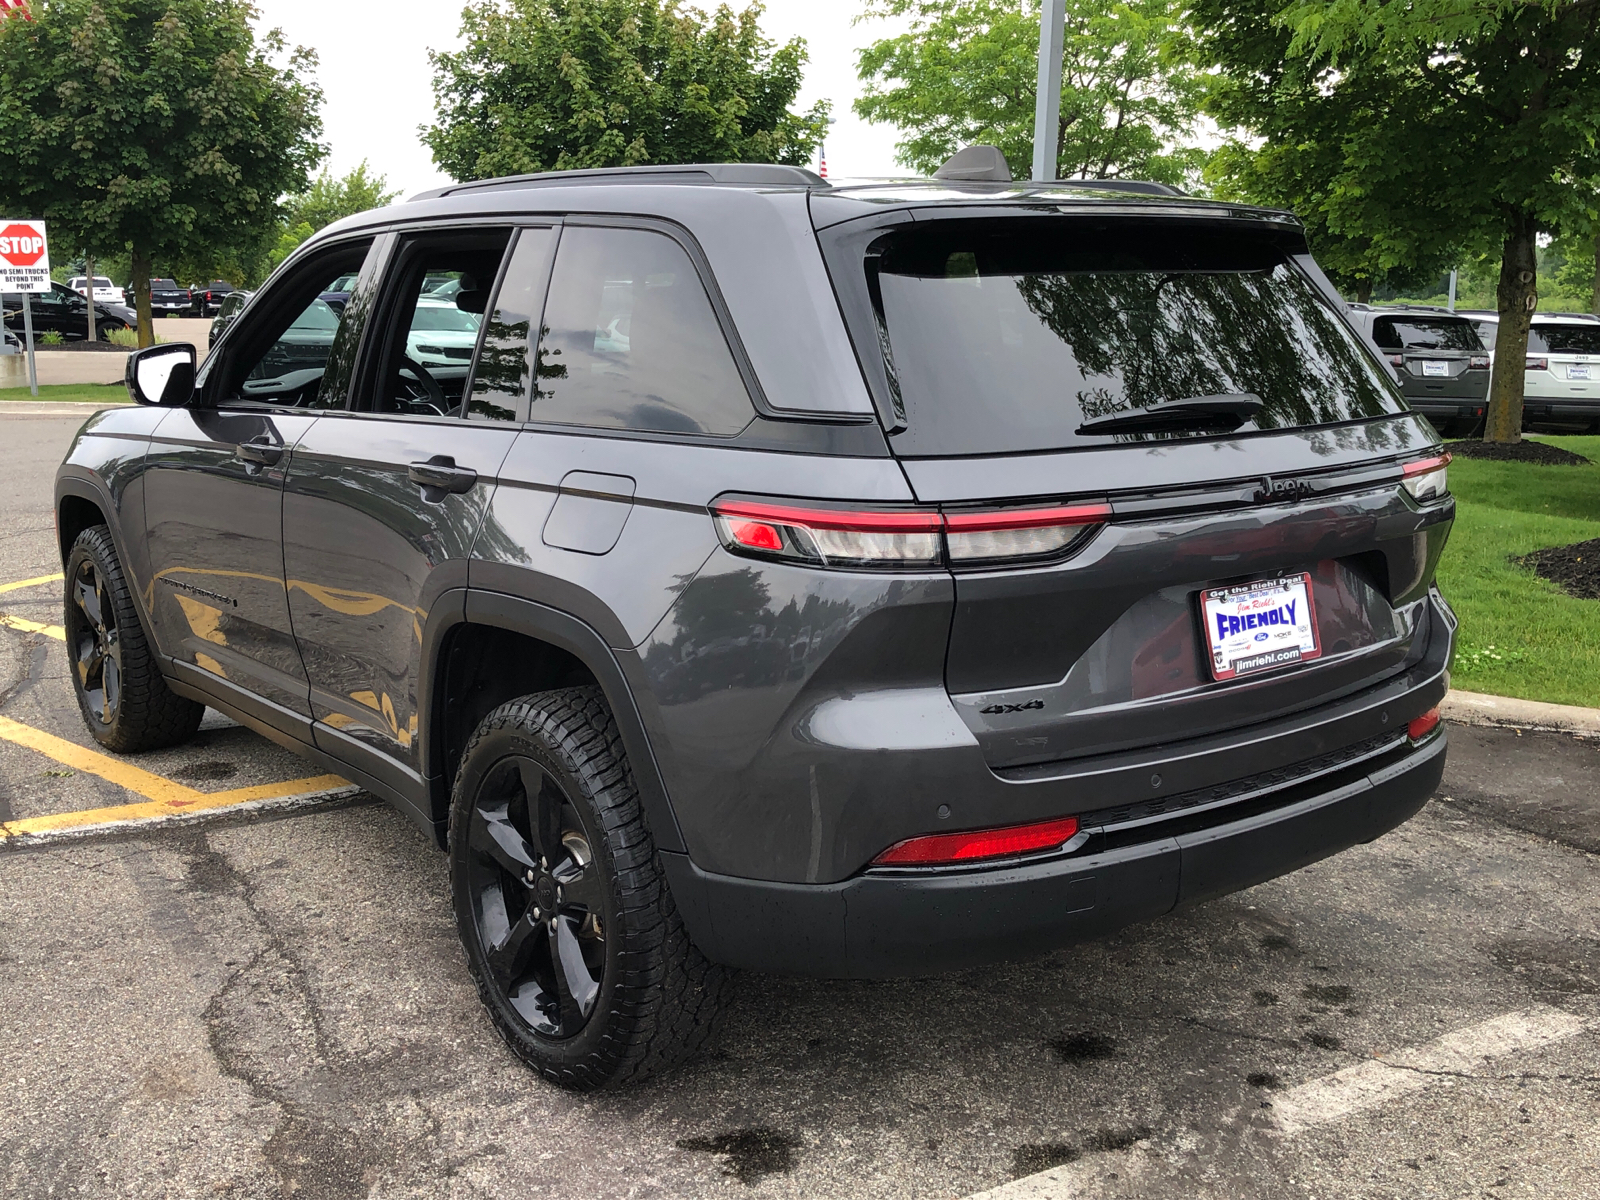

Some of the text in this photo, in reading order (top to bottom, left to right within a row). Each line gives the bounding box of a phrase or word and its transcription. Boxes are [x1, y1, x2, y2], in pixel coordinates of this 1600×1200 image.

[0, 236, 43, 254] STOP
[1210, 576, 1302, 598] Get the Riehl Deal
[1237, 598, 1275, 614] Jim Riehl's
[1216, 597, 1296, 641] FRIENDLY
[1236, 649, 1299, 673] jimriehl.com
